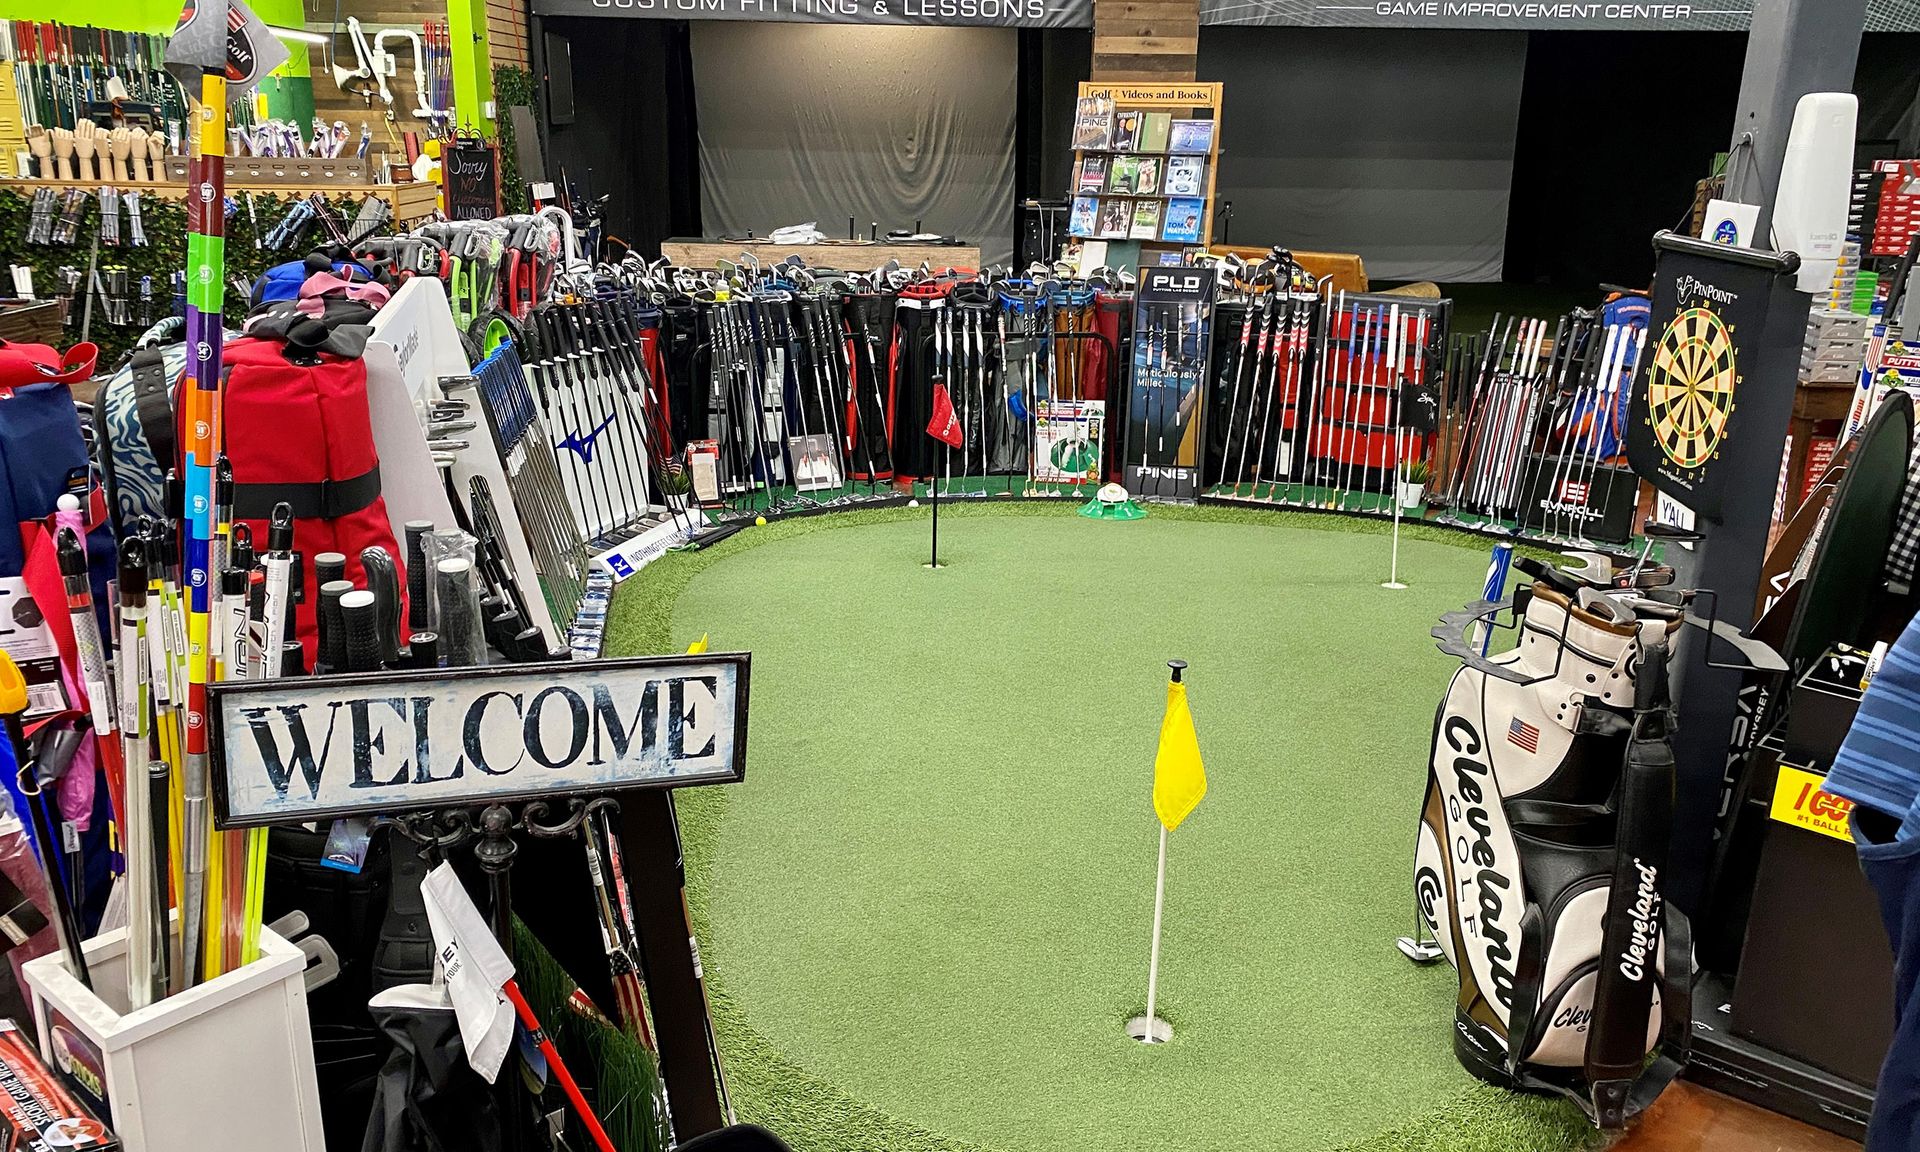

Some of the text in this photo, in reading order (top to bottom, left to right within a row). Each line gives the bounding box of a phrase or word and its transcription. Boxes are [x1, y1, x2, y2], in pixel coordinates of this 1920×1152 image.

[873, 0, 889, 15] &
[904, 0, 1044, 18] LESSONS
[1376, 2, 1690, 19] GAME IMPROVEMENT CENTER
[1091, 89, 1208, 99] Golf Videos and Books
[1081, 118, 1108, 127] PING
[449, 151, 488, 181] Sorry
[460, 176, 477, 193] NO
[456, 205, 492, 219] ALLOWED
[1152, 275, 1200, 289] PLD
[1136, 467, 1188, 480] PING
[1540, 499, 1604, 518] EVNROLL
[240, 675, 717, 799] WELCOME
[1797, 813, 1810, 824] #1
[1813, 819, 1840, 834] BALL
[1445, 715, 1515, 1010] Cleveland
[1449, 793, 1478, 938] GOLF
[1619, 862, 1657, 982] Cleveland
[1648, 892, 1662, 951] GOLF
[4, 1078, 30, 1101] GAME
[20, 1100, 51, 1126] SHORT
